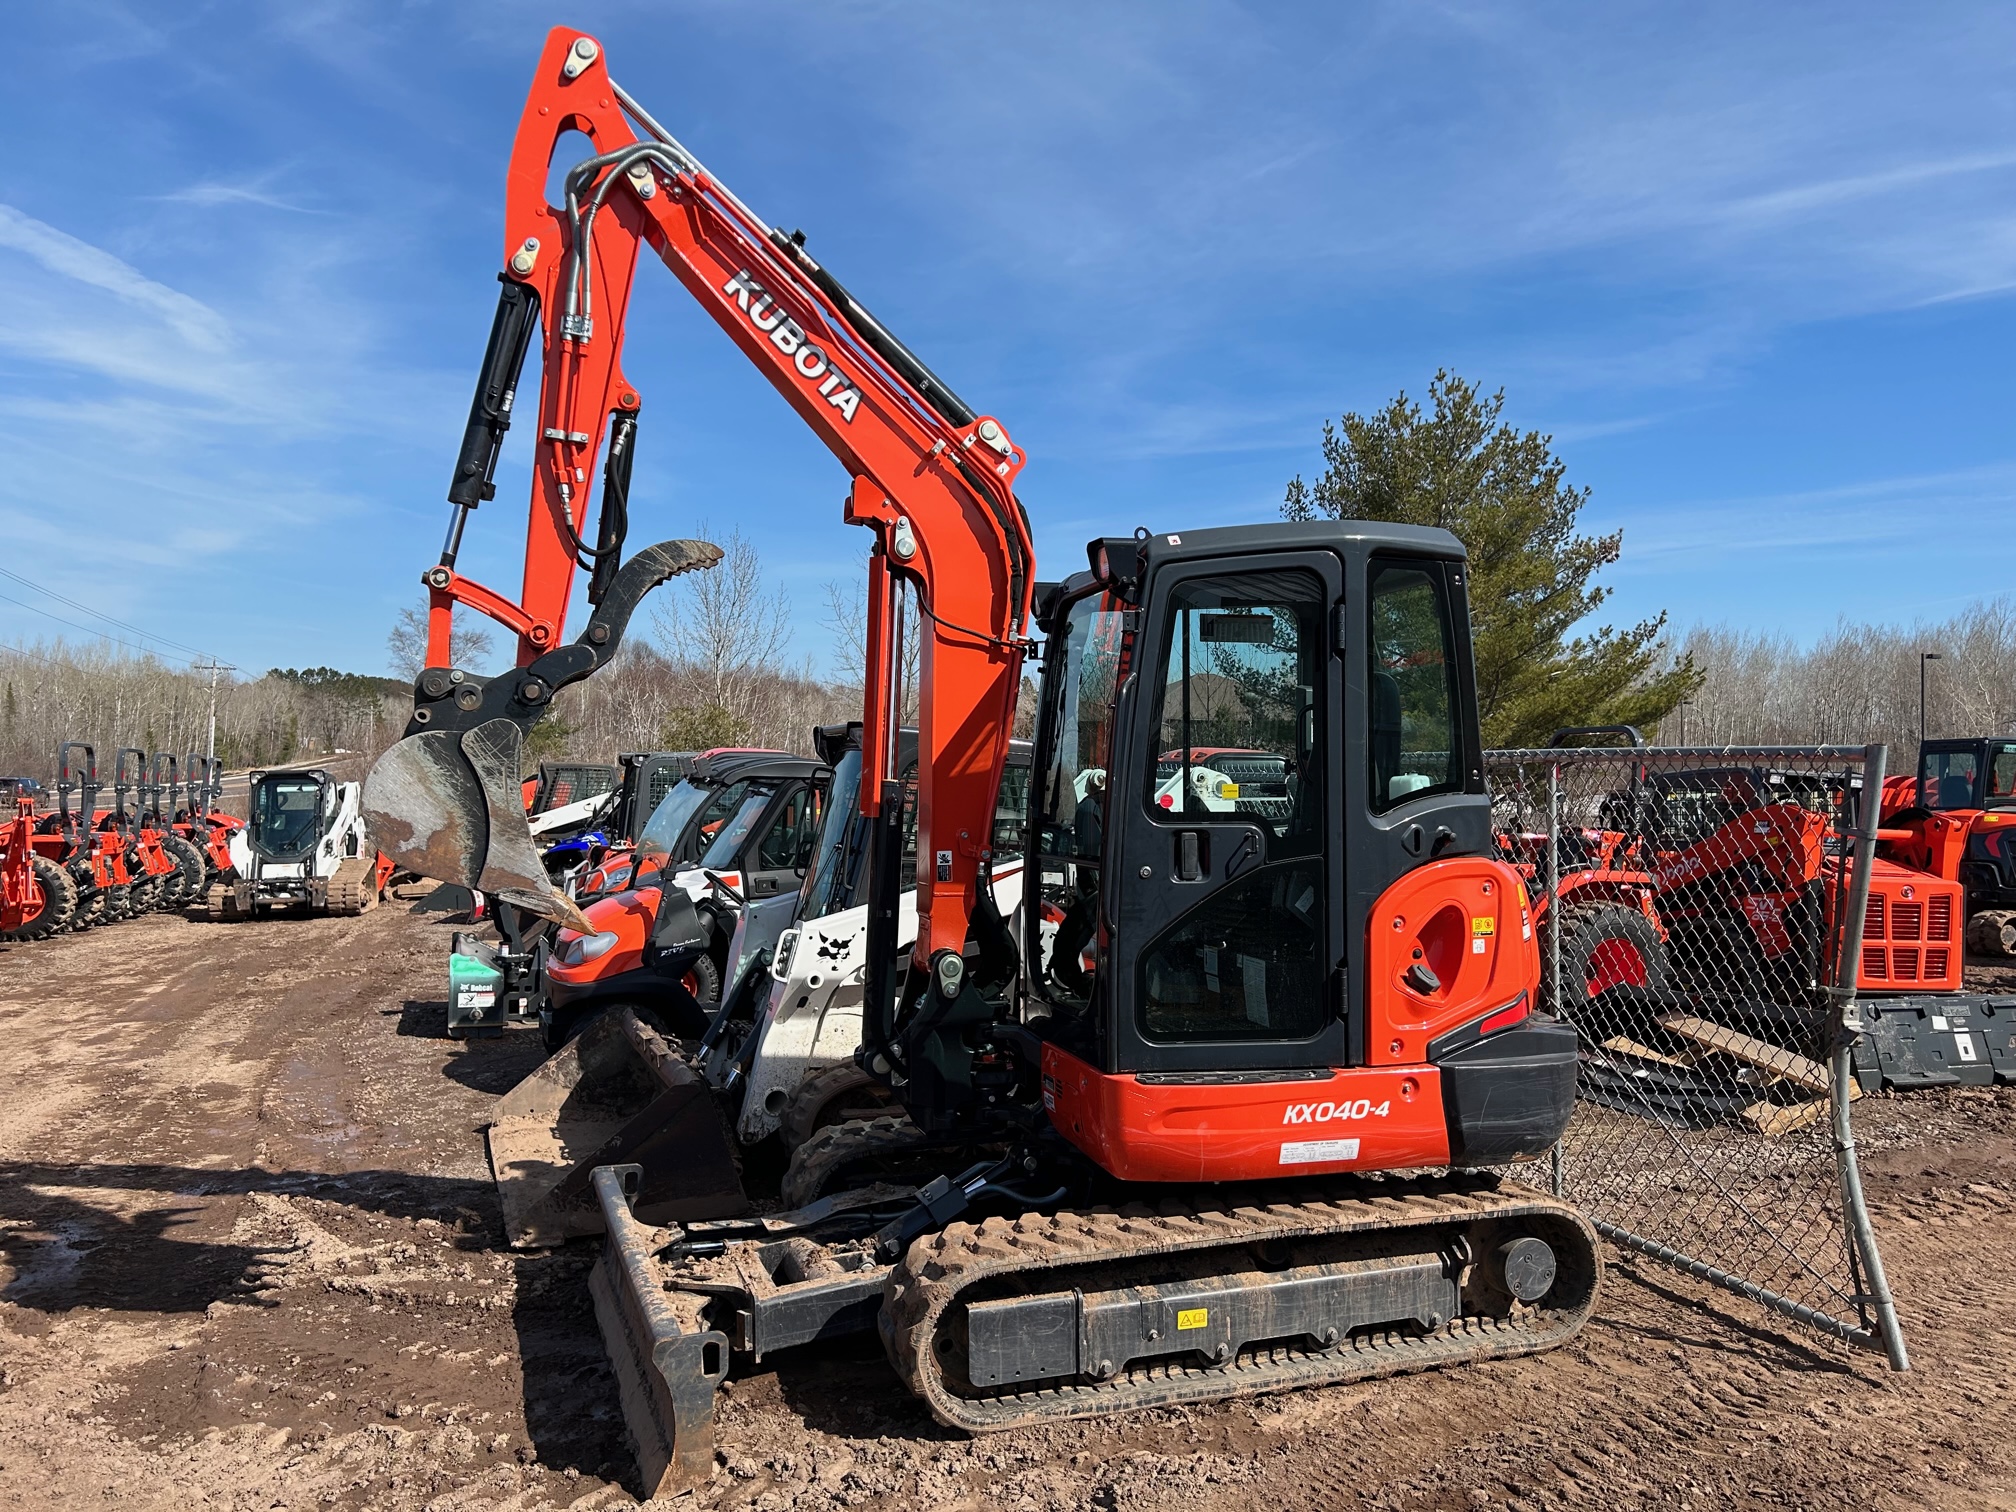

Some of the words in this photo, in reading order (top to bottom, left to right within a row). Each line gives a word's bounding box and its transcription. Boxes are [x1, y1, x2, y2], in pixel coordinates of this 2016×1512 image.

[722, 267, 862, 424] KUBOTA
[470, 983, 493, 992] Bobcat
[1282, 1099, 1391, 1125] KX040-4
